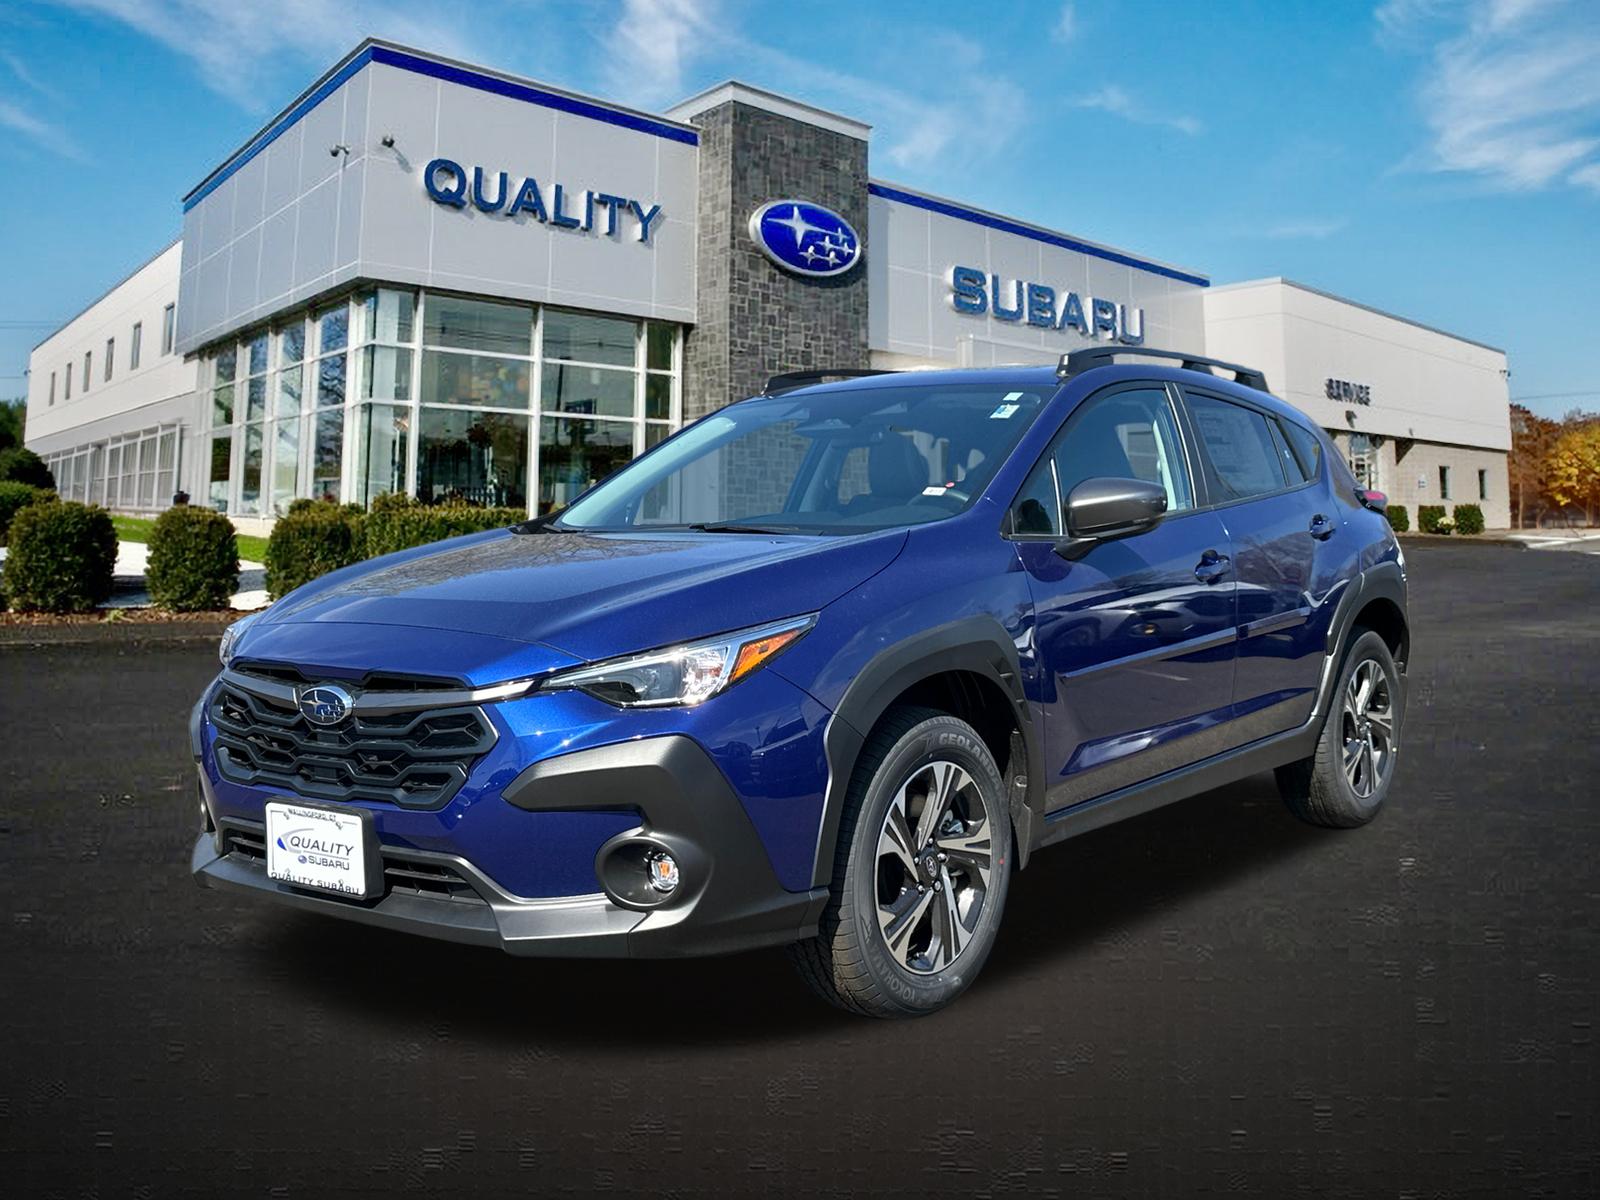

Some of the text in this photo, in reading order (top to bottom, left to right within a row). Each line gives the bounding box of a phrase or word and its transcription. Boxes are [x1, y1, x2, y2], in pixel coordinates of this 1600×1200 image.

[423, 158, 662, 243] QUALITY
[951, 265, 1145, 346] SUBARU
[290, 836, 354, 856] QUALITY
[308, 855, 350, 870] SUBARU
[270, 871, 314, 886] QUALITY
